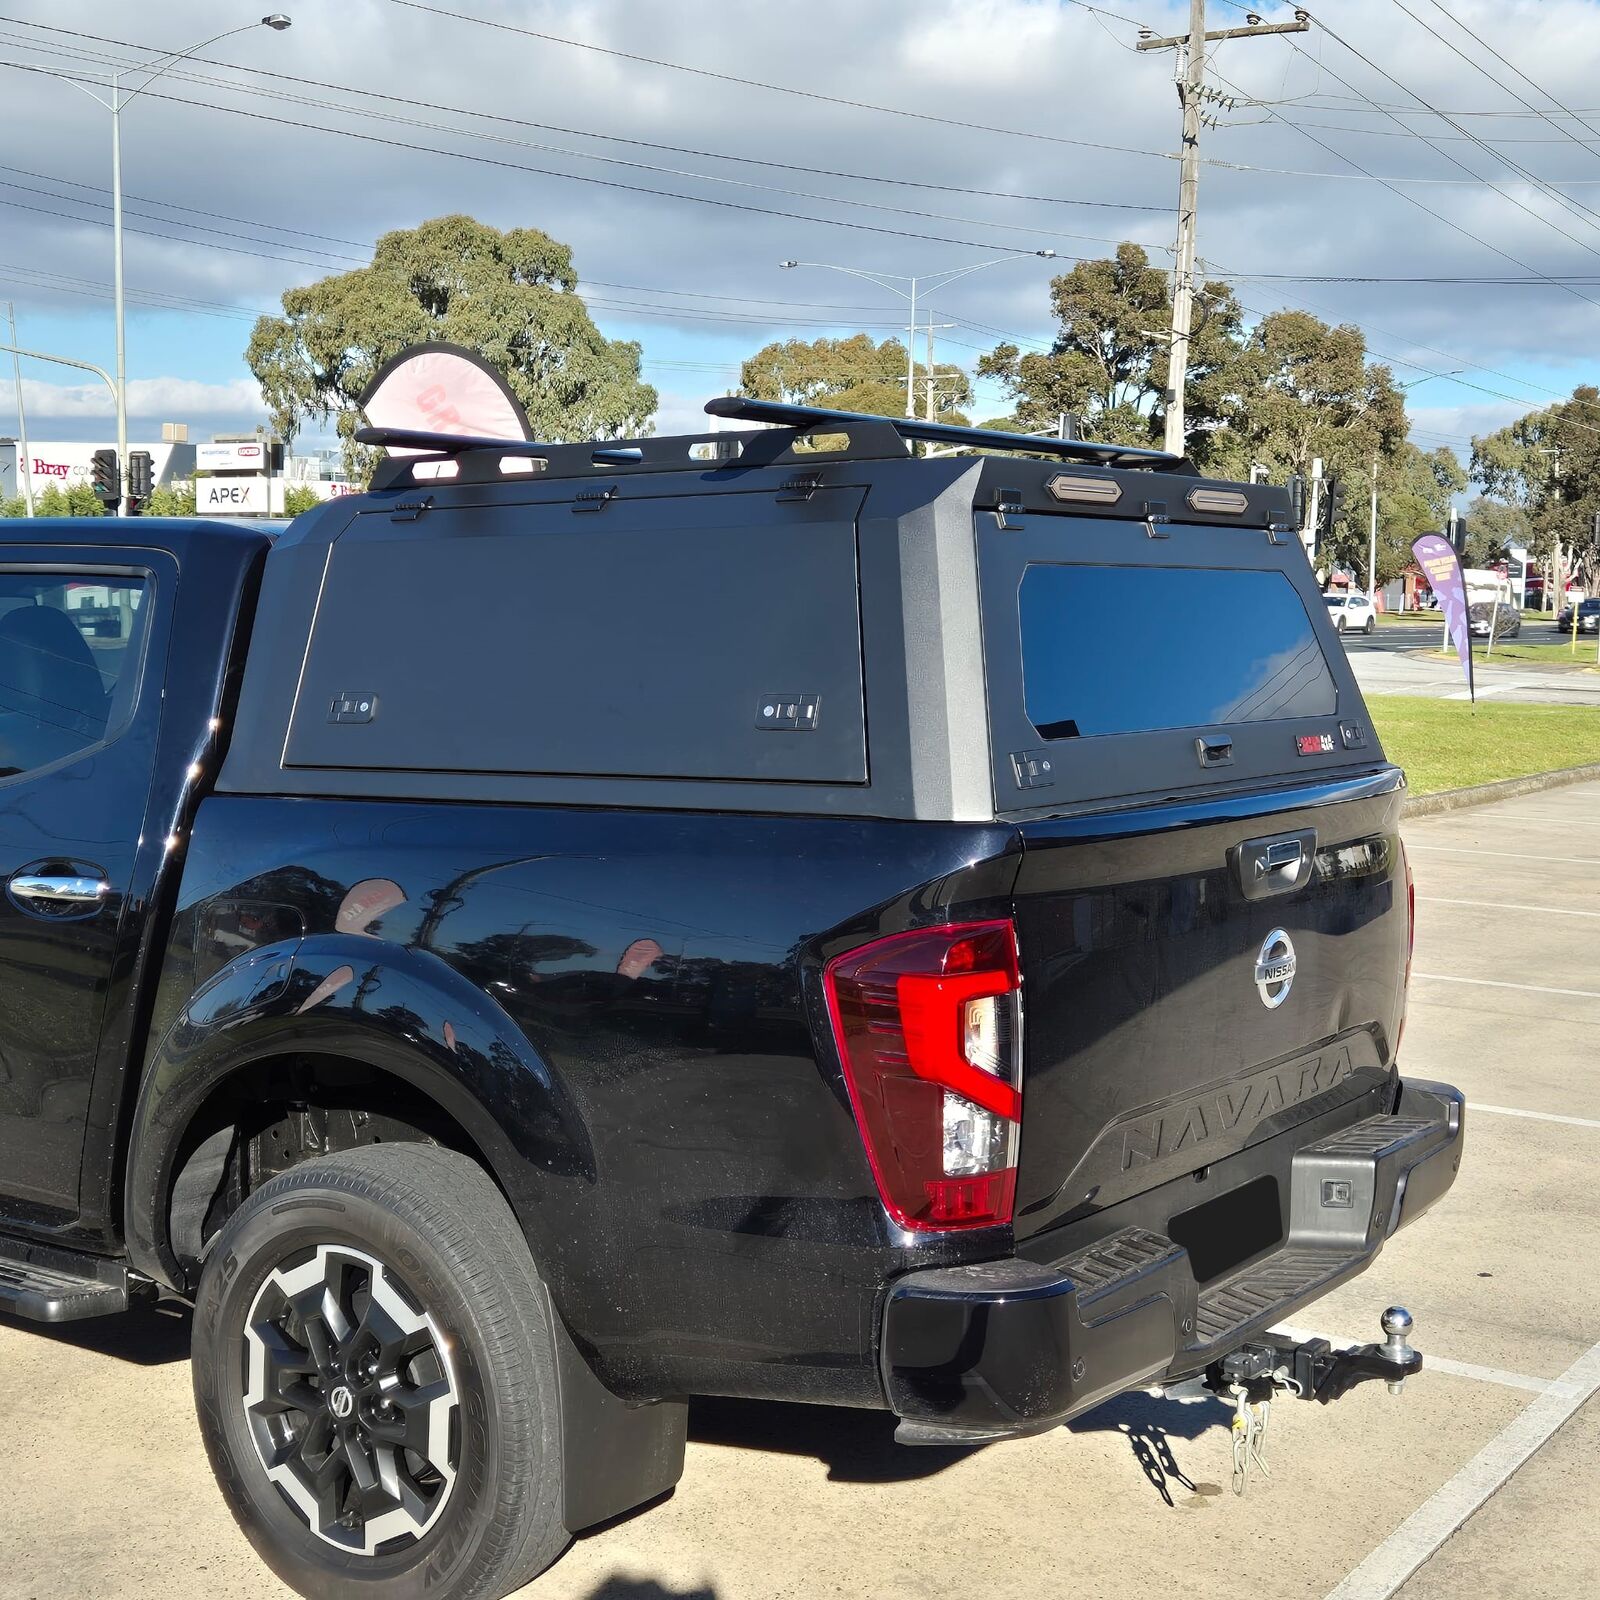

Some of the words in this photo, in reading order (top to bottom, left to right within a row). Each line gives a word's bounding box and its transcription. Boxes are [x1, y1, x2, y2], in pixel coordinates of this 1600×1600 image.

[33, 459, 70, 479] Bray
[209, 487, 251, 505] APEX
[1264, 961, 1296, 980] NISSAN
[1120, 1045, 1354, 1172] NAVARA
